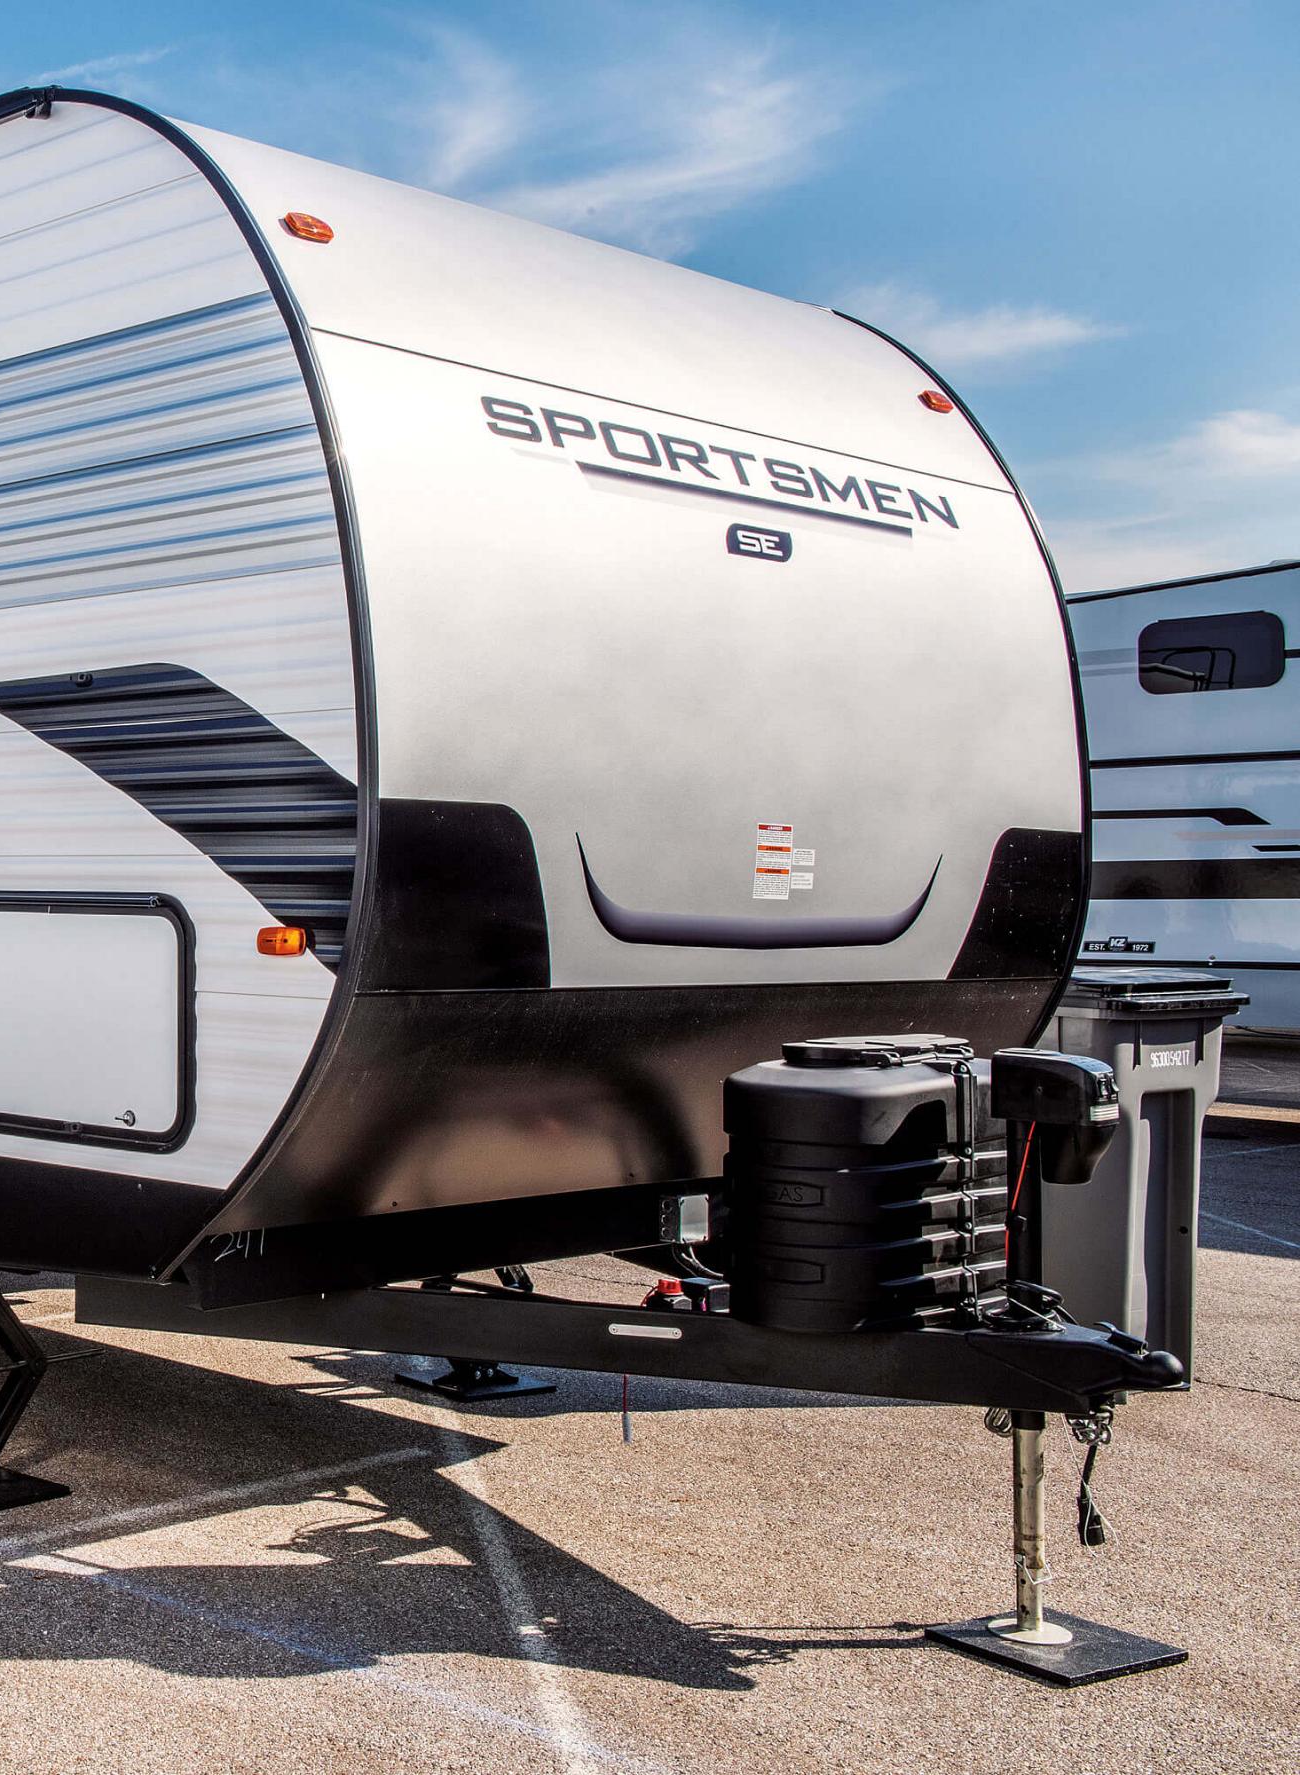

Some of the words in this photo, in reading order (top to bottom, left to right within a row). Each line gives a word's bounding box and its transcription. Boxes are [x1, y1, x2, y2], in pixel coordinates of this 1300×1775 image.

[480, 396, 959, 529] SPORTSMEN
[736, 529, 783, 556] SE
[1089, 943, 1106, 951] EST.
